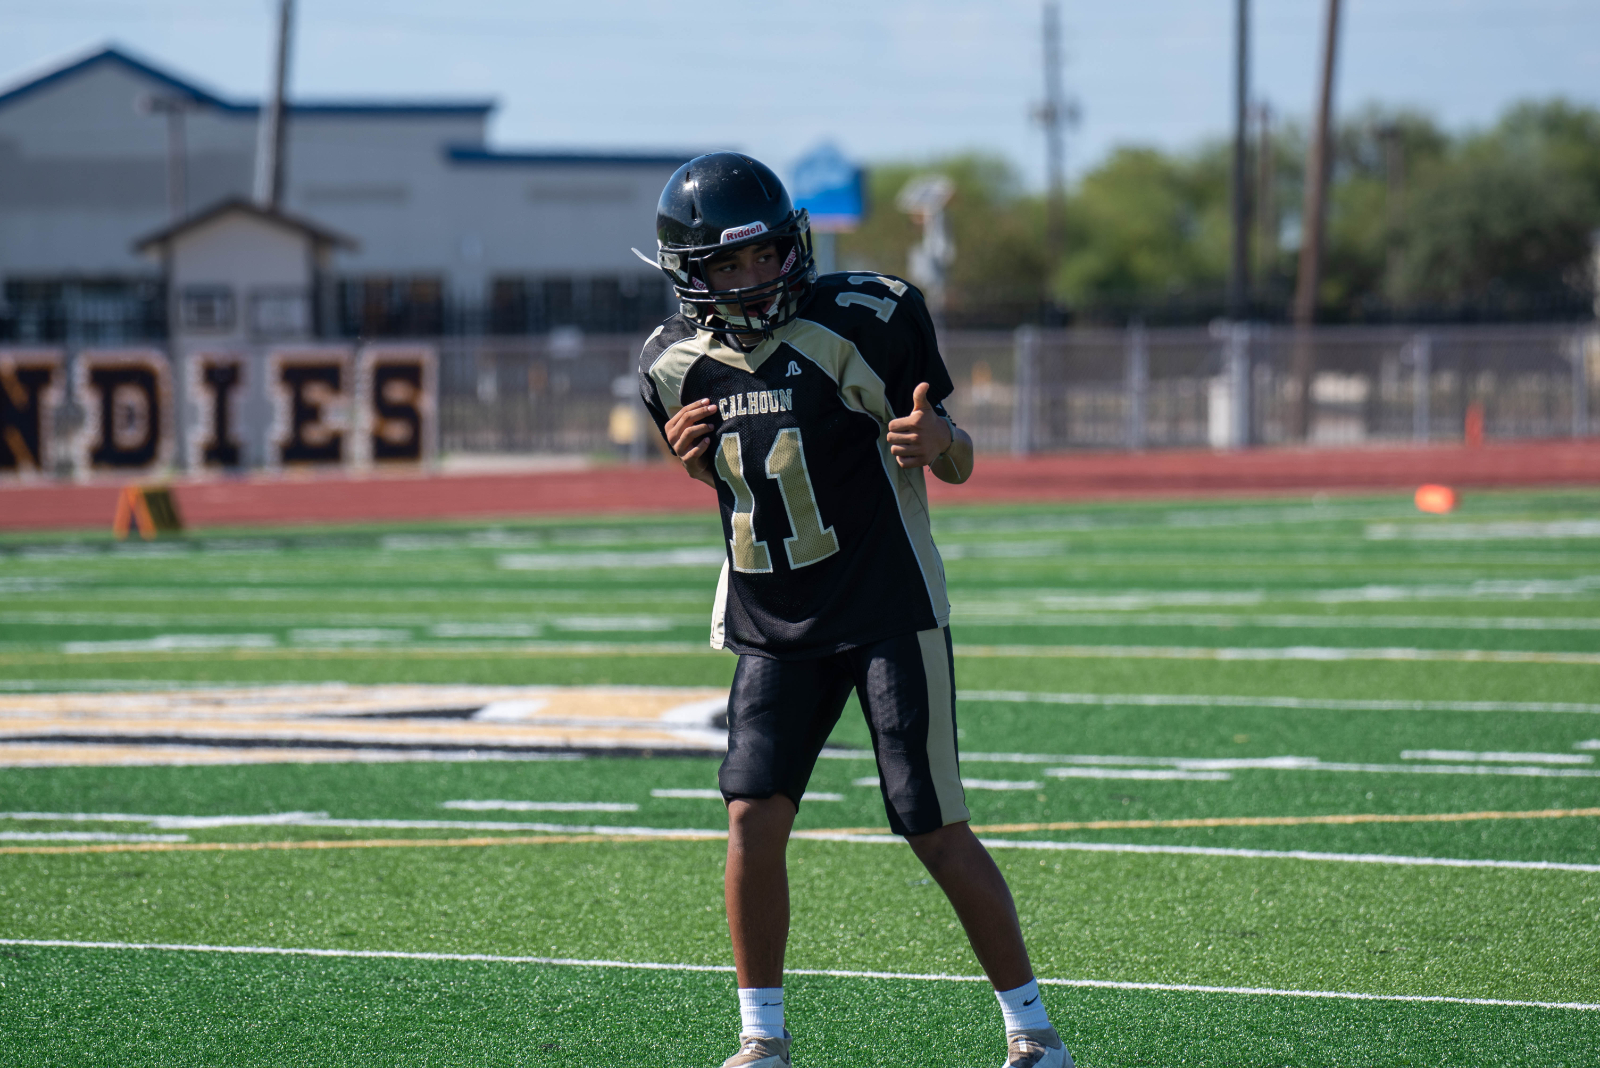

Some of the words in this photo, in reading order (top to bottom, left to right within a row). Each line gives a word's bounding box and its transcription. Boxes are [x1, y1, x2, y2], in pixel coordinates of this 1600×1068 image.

[725, 224, 763, 241] Riddell
[834, 275, 908, 324] 11
[718, 388, 793, 421] CALHOUN
[714, 427, 840, 573] 11
